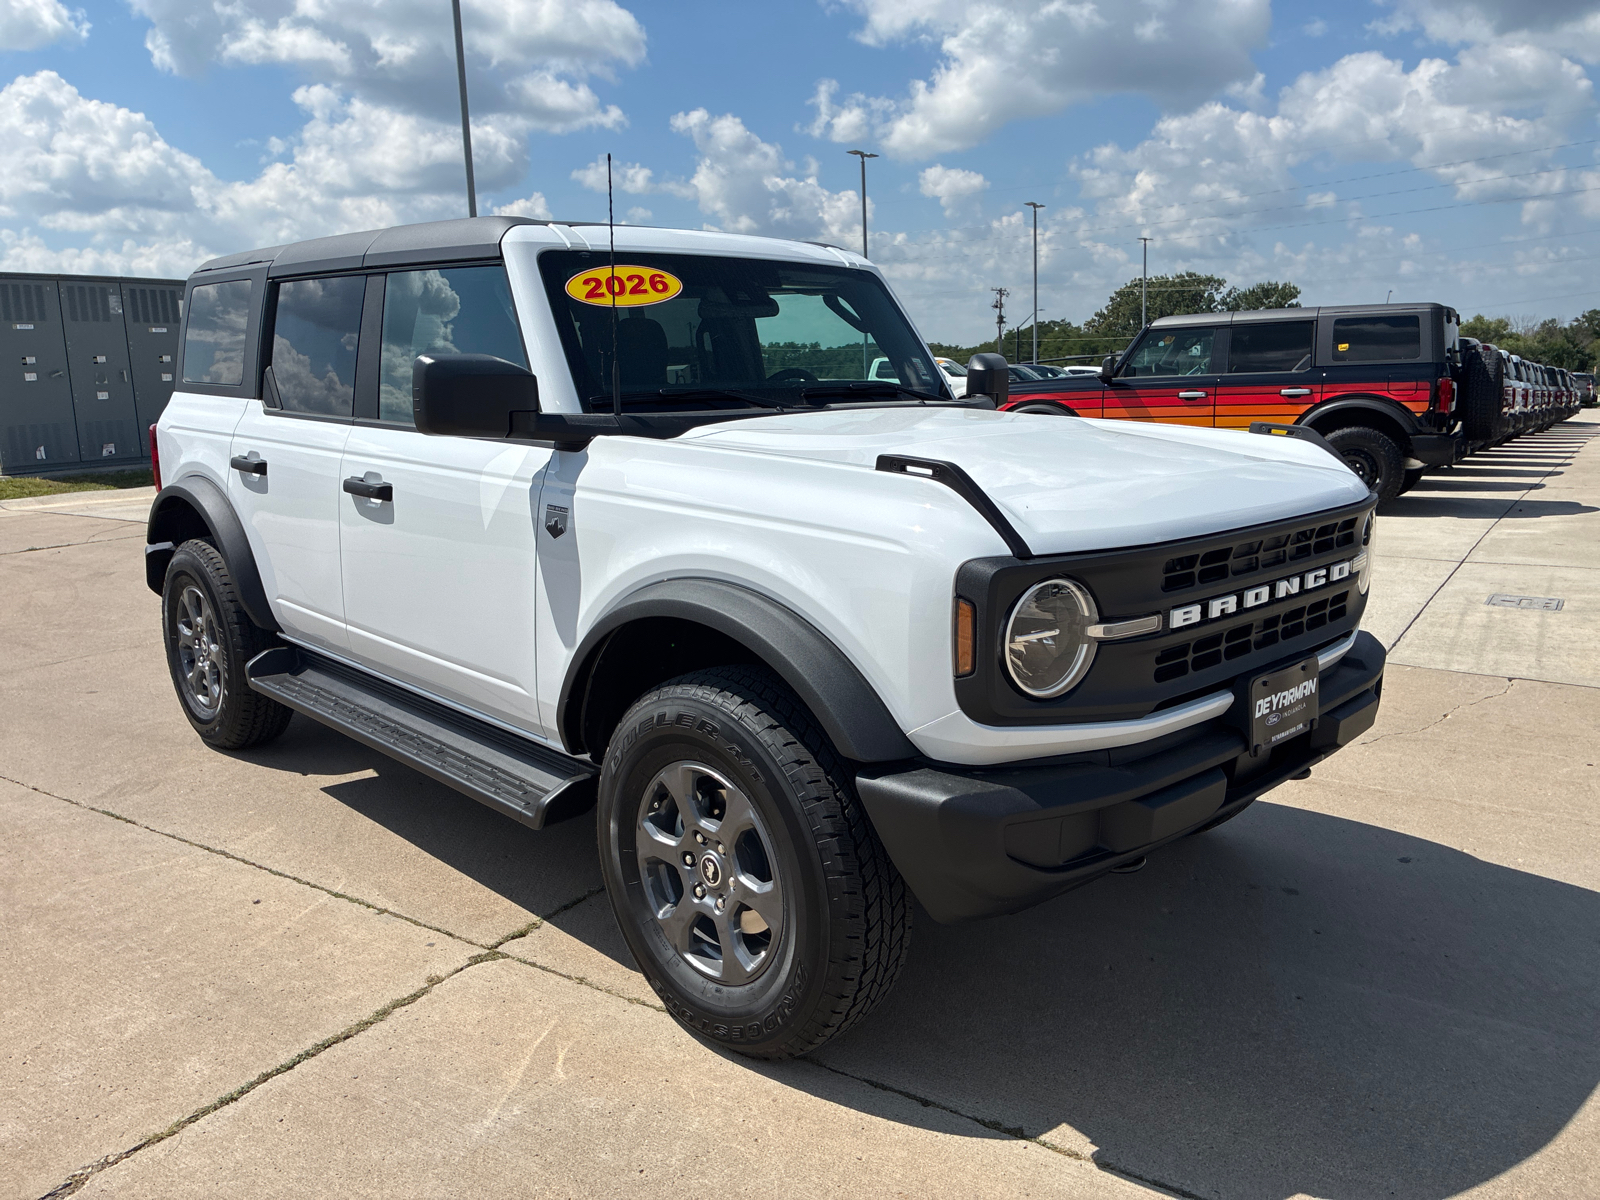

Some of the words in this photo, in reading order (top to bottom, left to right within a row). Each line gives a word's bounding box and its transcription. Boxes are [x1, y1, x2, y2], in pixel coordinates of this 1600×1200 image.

[582, 274, 670, 299] 2026
[1169, 561, 1350, 629] BRONCO
[1255, 678, 1317, 719] DEYARMAN
[610, 710, 722, 776] DUELER
[724, 742, 766, 785] A/T
[650, 959, 809, 1042] BRIDGESTONE
